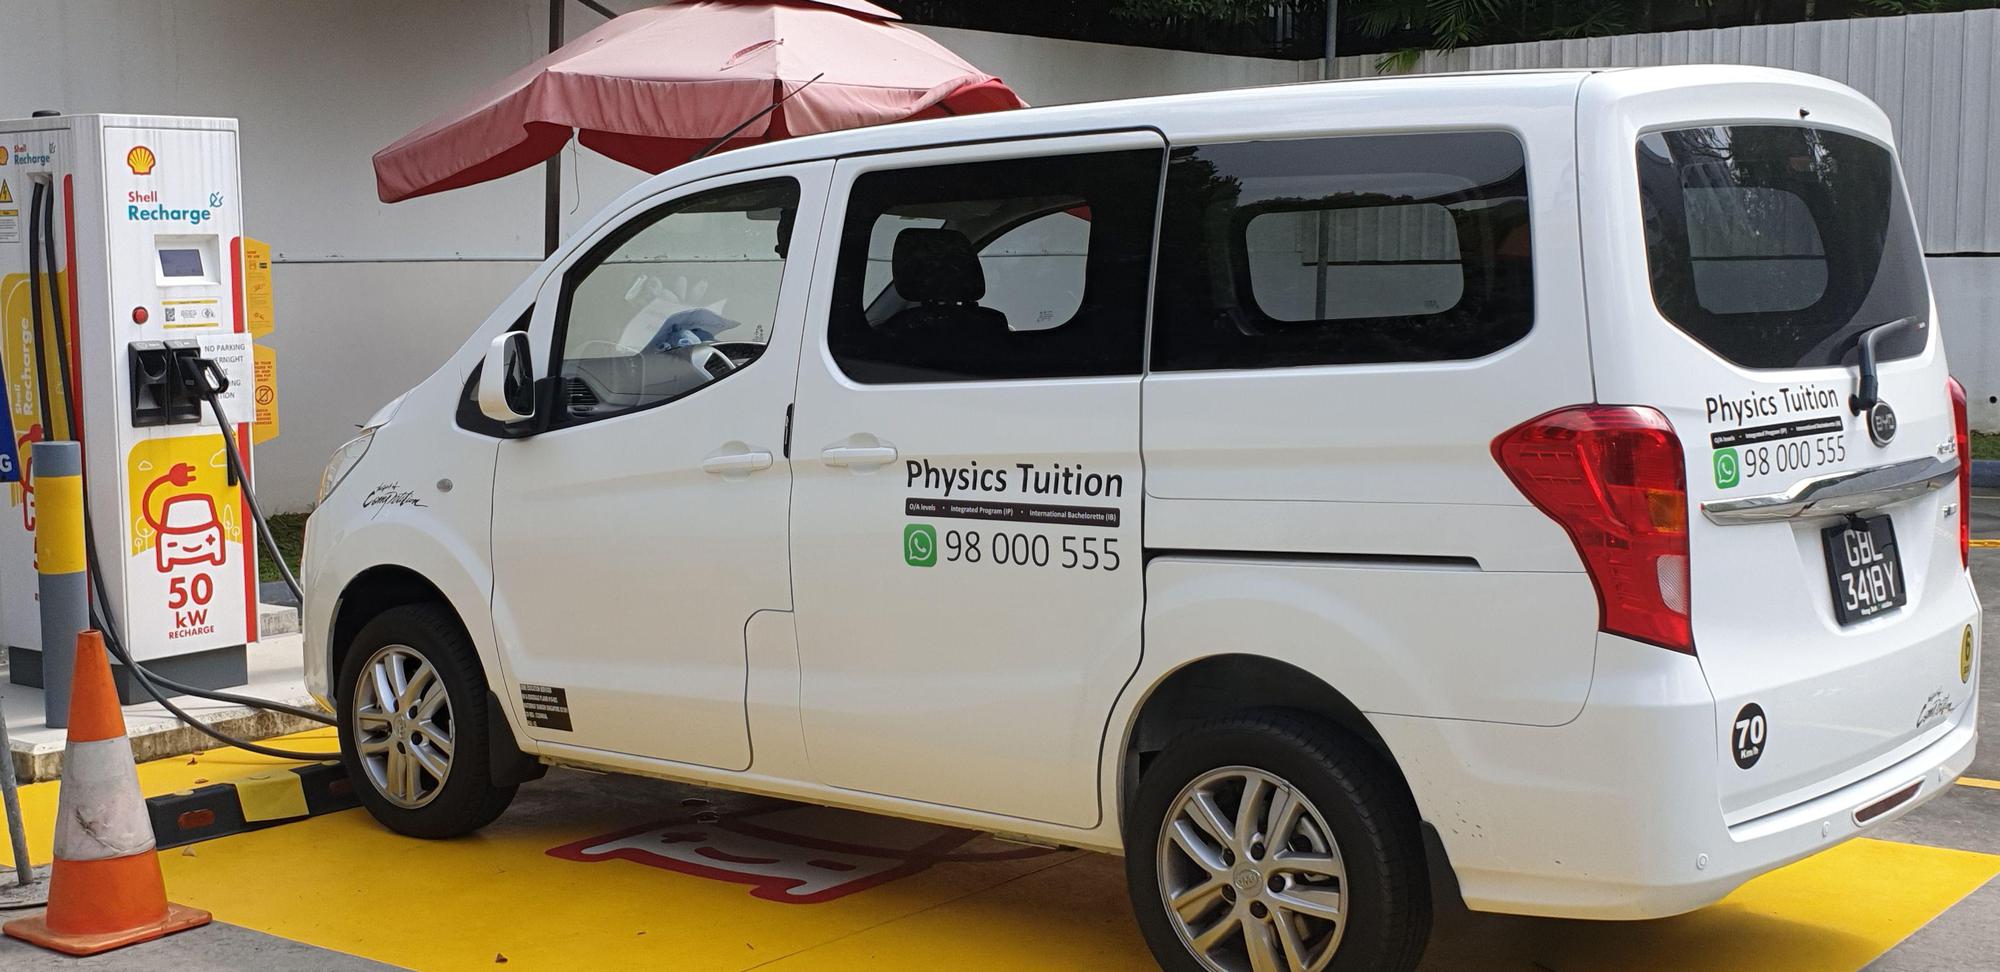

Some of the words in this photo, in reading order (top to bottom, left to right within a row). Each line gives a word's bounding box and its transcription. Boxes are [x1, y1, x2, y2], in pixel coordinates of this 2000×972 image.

[14, 144, 26, 153] Shell
[14, 153, 50, 166] Recharge
[128, 190, 158, 203] Shell
[128, 203, 211, 225] Recharge
[217, 343, 246, 351] PARKING
[21, 319, 33, 416] Recharge
[1705, 391, 1778, 426] Physics
[1779, 384, 1839, 413] Tuition
[1745, 447, 1770, 478] 98
[1776, 440, 1811, 472] 000
[1817, 435, 1846, 466] 555
[906, 459, 1008, 497] Physics
[1016, 463, 1123, 498] Tuition
[920, 503, 936, 511] levels
[950, 505, 979, 515] Integrated
[979, 506, 1003, 515] Program
[1003, 507, 1014, 517] (IP)
[1029, 509, 1067, 518] International
[1067, 510, 1105, 520] Bachelorette
[945, 530, 981, 563] 98
[992, 532, 1050, 567] 000
[1061, 535, 1120, 571] 555
[1843, 529, 1884, 567] GBL
[168, 572, 214, 609] 50
[1841, 561, 1896, 611] 3418Y
[168, 625, 215, 639] RECHARGE
[176, 608, 208, 629] kW
[1735, 715, 1764, 749] 70
